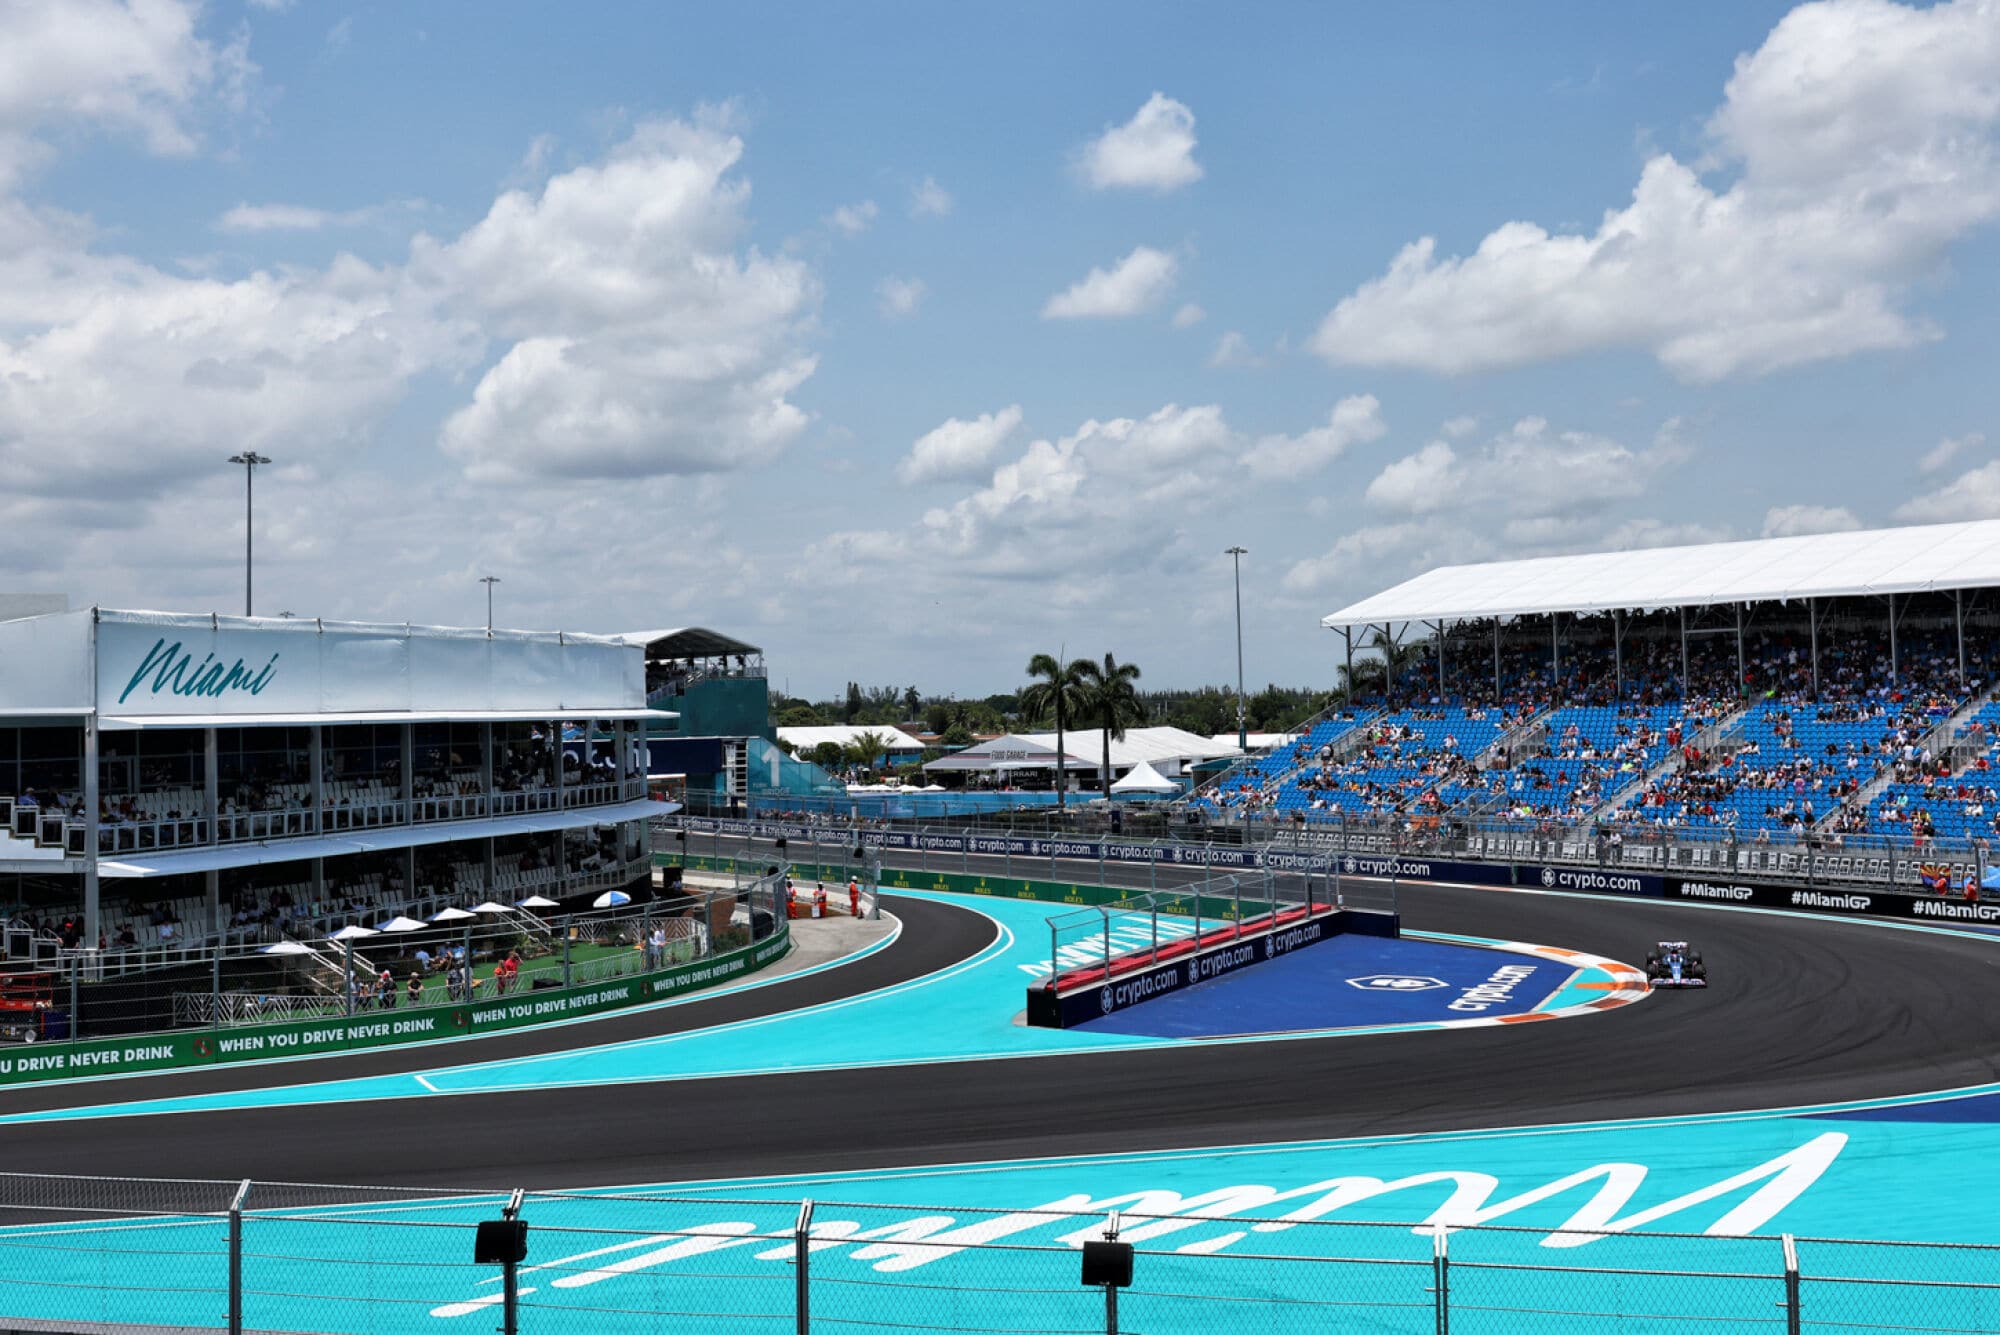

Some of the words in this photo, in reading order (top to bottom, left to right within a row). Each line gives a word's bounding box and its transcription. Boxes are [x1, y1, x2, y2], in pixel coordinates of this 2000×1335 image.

[117, 637, 279, 704] Miami
[1559, 870, 1641, 892] crypto.com
[1681, 882, 1753, 899] #MiamiGP
[1791, 890, 1871, 910] #MiamiGP
[1275, 923, 1321, 951] crypto.com
[1200, 943, 1254, 976] crypto.com
[653, 976, 675, 992] WHEN
[676, 973, 691, 987] YOU
[1116, 967, 1178, 1004] crypto.com
[1447, 965, 1538, 1012] crypto.com
[472, 1007, 506, 1024] WHEN
[509, 1004, 532, 1018] YOU
[535, 999, 566, 1014] DRIVE
[569, 993, 599, 1009] NEVER
[600, 987, 629, 1003] DRINK
[219, 1036, 264, 1052] WHEN
[267, 1032, 298, 1048] YOU
[303, 1028, 344, 1044] DRIVE
[347, 1024, 390, 1039] NEVER
[393, 1018, 435, 1034] DRINK
[17, 1055, 65, 1072] DRIVE
[69, 1050, 120, 1067] NEVER
[124, 1045, 174, 1062] DRINK
